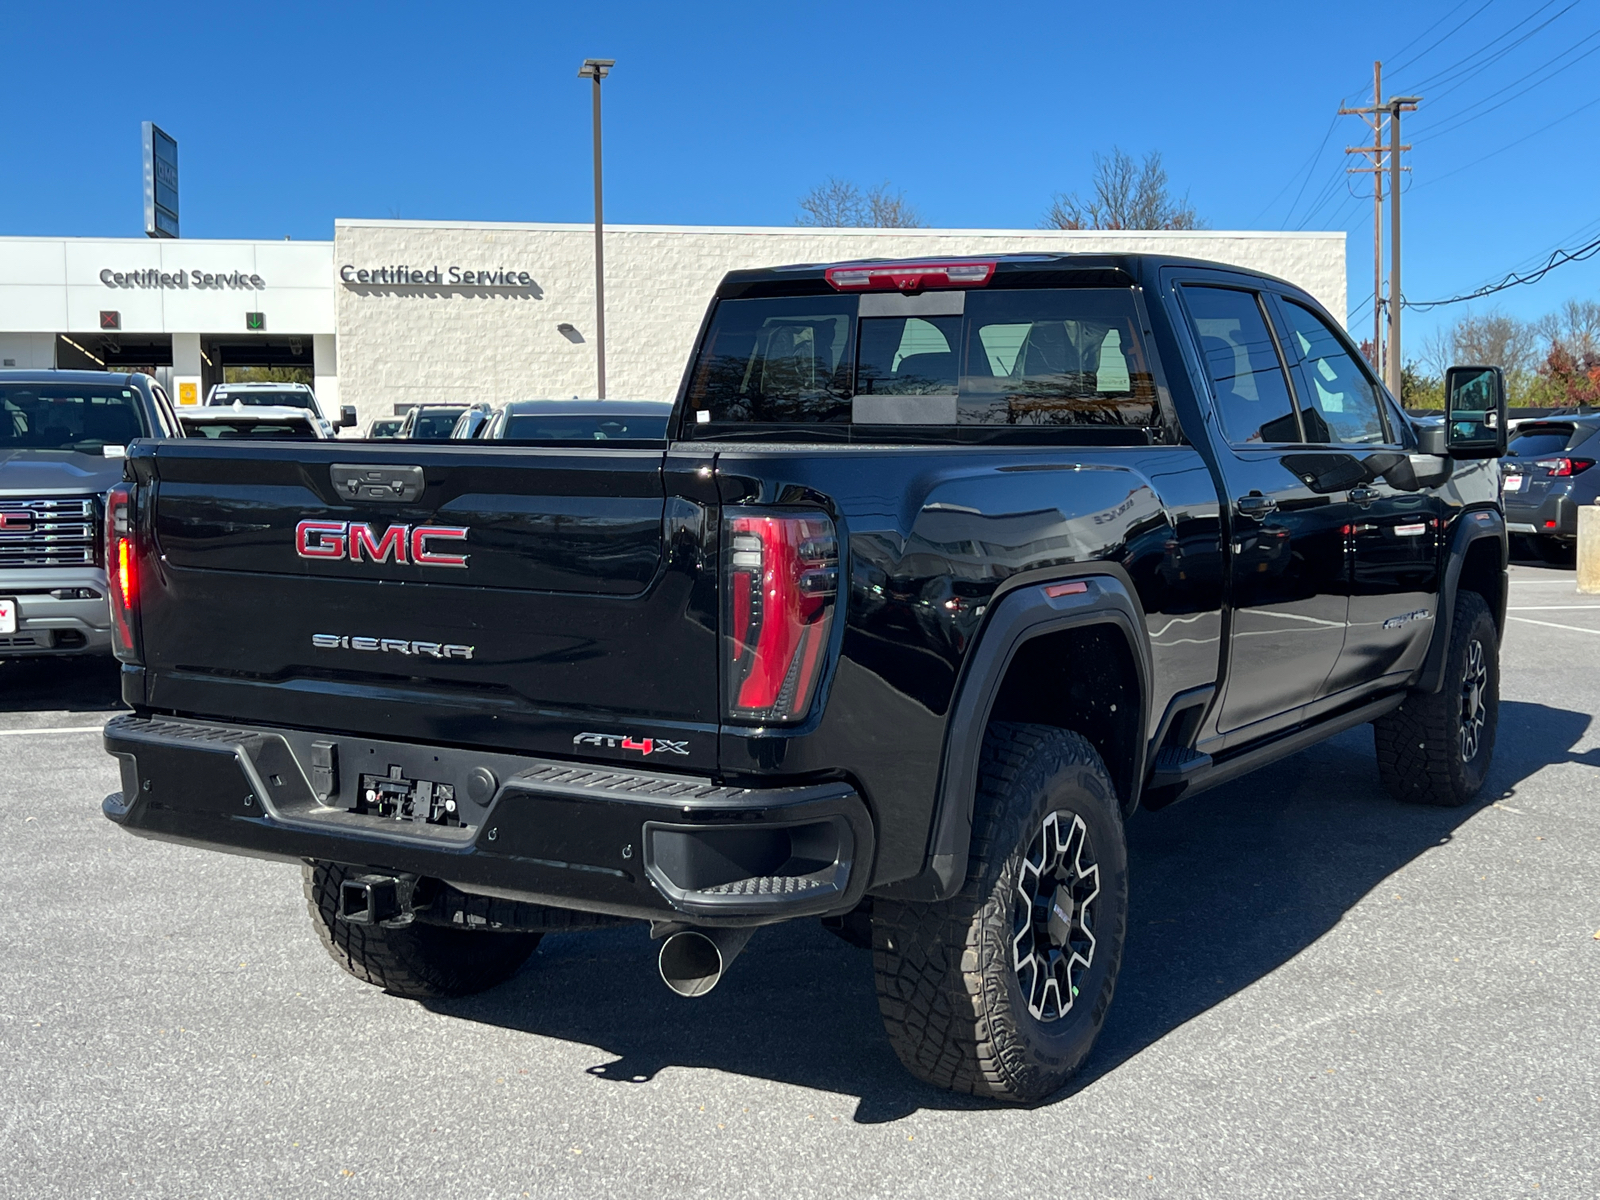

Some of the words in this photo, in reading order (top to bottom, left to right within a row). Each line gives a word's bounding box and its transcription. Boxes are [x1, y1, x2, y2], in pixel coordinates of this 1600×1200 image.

[99, 268, 184, 286] Certified
[191, 269, 261, 287] Service
[340, 264, 438, 285] Certified
[448, 266, 531, 286] Service
[295, 518, 470, 569] GMC
[312, 632, 476, 660] SIERRA
[572, 731, 690, 756] AT4X
